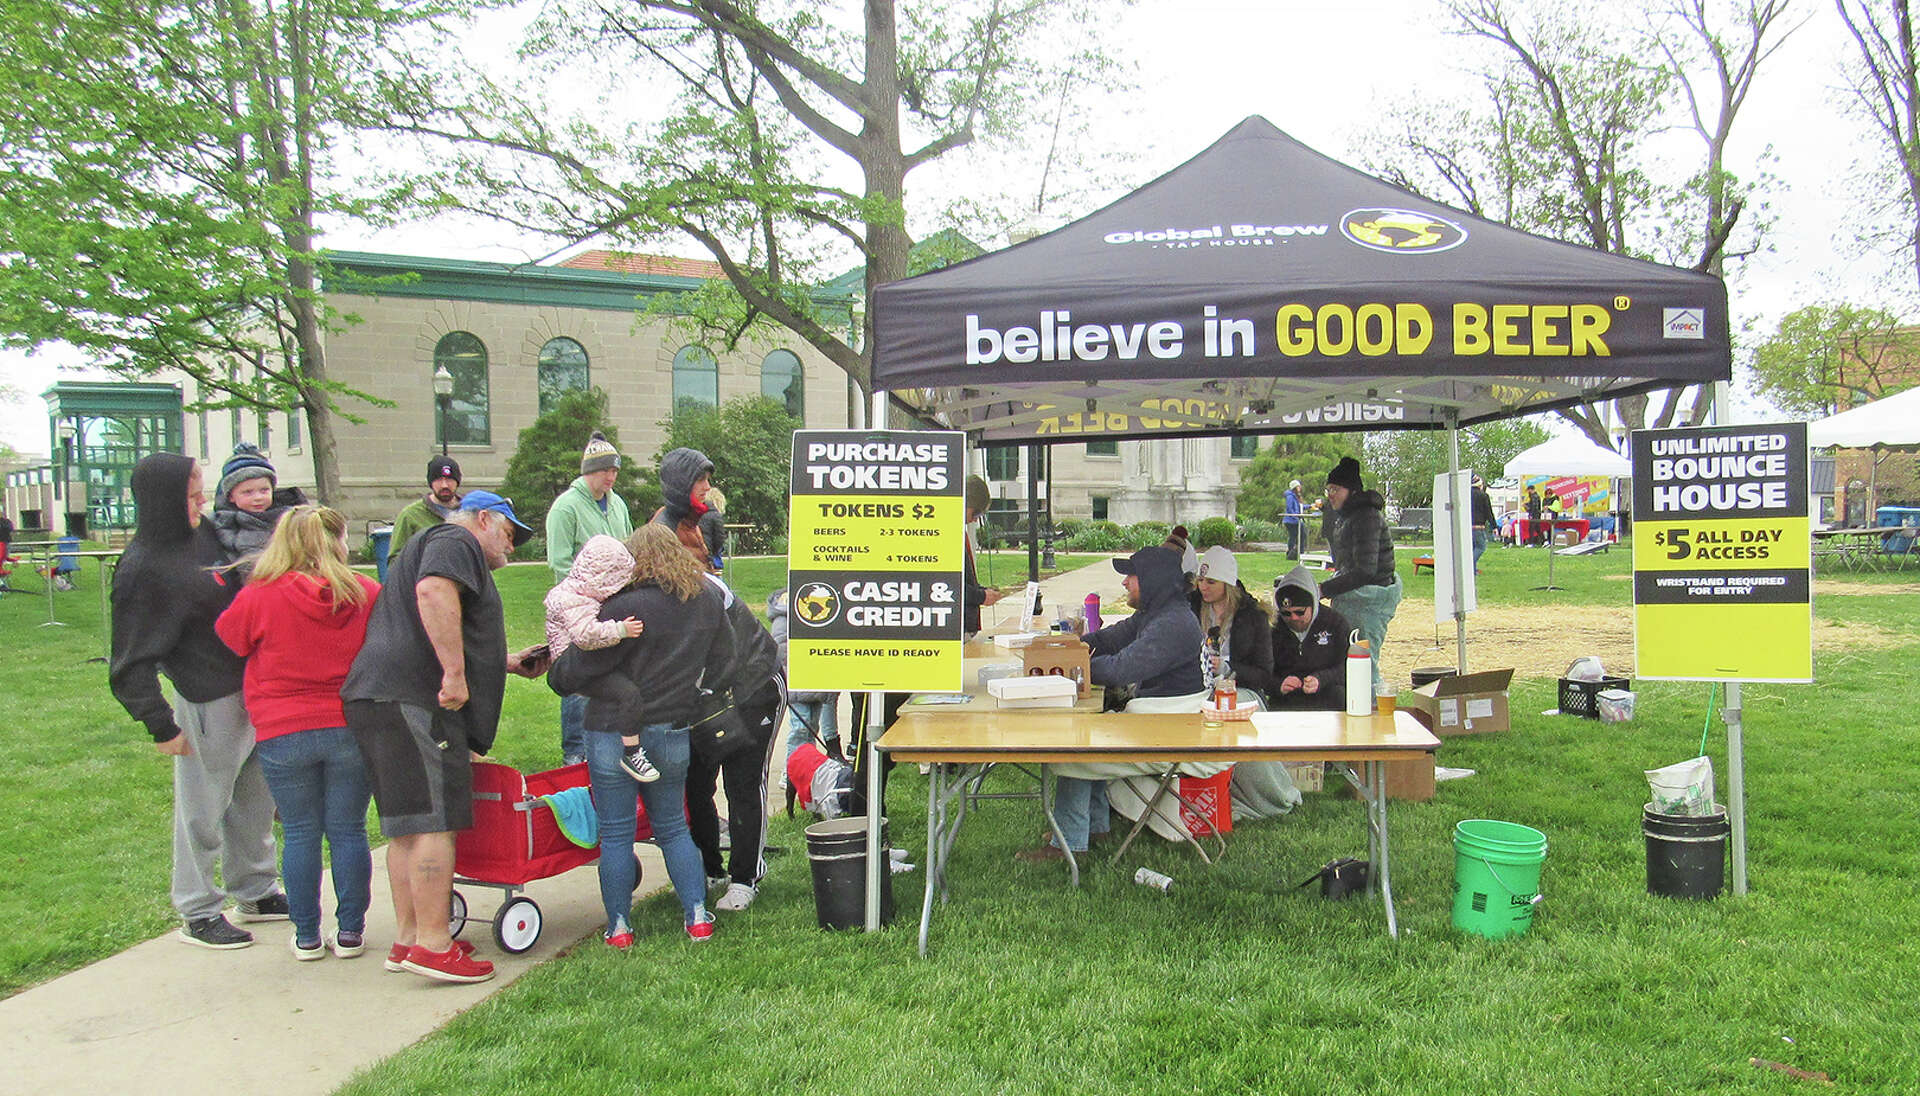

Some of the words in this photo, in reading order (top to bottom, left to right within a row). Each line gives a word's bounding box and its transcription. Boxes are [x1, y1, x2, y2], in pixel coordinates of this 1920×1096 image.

[1104, 225, 1223, 244] Global
[1231, 223, 1329, 237] Brew
[1166, 240, 1201, 249] TAP
[1209, 238, 1274, 247] HOUSE
[965, 310, 1184, 364] believe
[1203, 305, 1255, 357] in
[1275, 303, 1433, 357] GOOD
[808, 443, 947, 463] PURCHASE
[1651, 435, 1786, 456] UNLIMITED
[1652, 454, 1786, 481] BOUNCE
[807, 466, 948, 490] TOKENS
[1652, 482, 1787, 511] HOUSE
[819, 503, 904, 518] TOKENS
[912, 503, 935, 520] $2
[814, 528, 846, 536] BEERS
[880, 528, 895, 537] 2-3
[898, 528, 940, 537] TOKENS
[1696, 531, 1733, 544] ALL
[1741, 529, 1783, 543] DAY
[813, 545, 870, 554] COCKTAILS
[1696, 546, 1769, 560] ACCESS
[813, 554, 821, 562] &
[825, 554, 853, 562] WINE
[886, 555, 893, 563] 4
[897, 555, 939, 563] TOKENS
[1656, 577, 1725, 587] WRISTBAND
[1727, 576, 1786, 588] REQUIRED
[1688, 587, 1712, 595] FOR
[1714, 585, 1753, 595] ENTRY
[844, 581, 920, 602] CASH
[930, 582, 955, 603] &
[846, 606, 953, 627] CREDIT
[809, 648, 851, 657] PLEASE
[855, 648, 884, 657] HAVE
[888, 649, 899, 657] ID
[903, 649, 940, 657] READY
